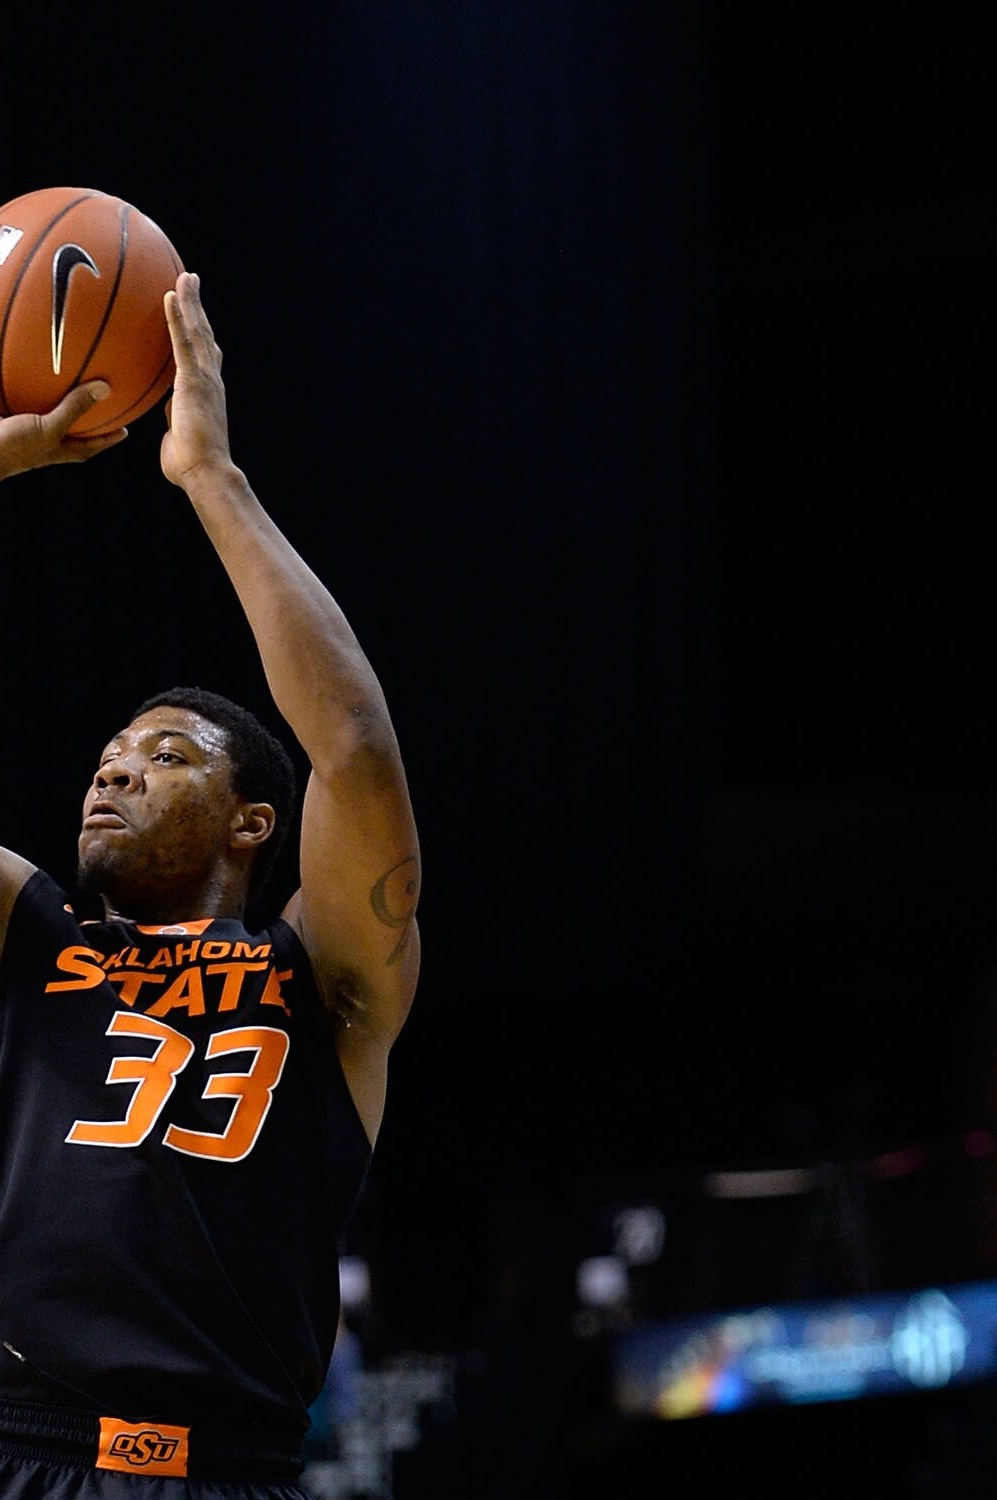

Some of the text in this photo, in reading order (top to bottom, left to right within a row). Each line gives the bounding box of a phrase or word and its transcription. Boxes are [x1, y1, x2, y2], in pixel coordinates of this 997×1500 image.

[101, 940, 273, 970] KLAHOM
[64, 1010, 290, 1163] 33
[107, 1429, 181, 1468] OSU
